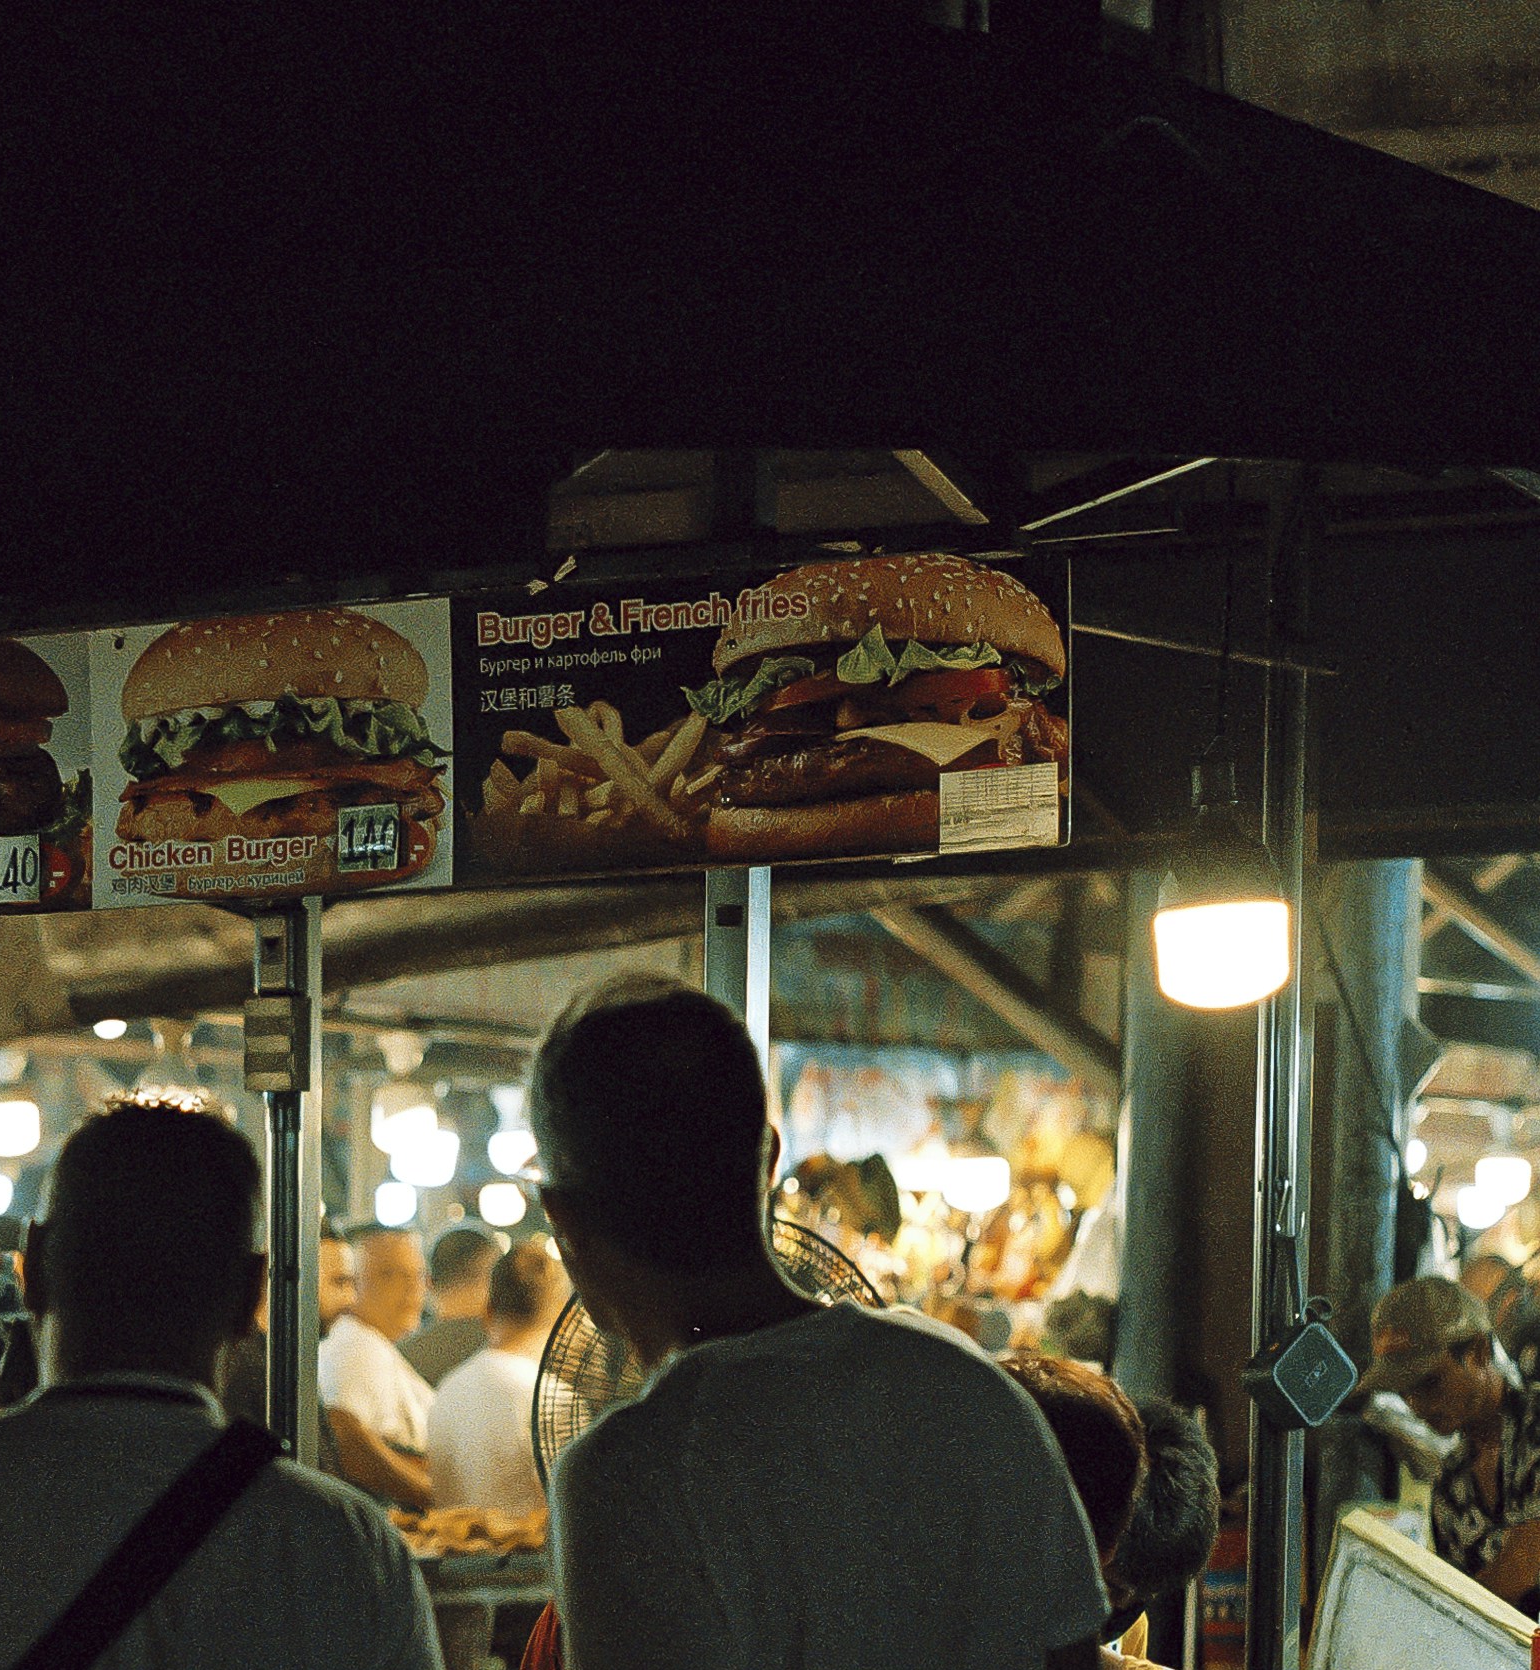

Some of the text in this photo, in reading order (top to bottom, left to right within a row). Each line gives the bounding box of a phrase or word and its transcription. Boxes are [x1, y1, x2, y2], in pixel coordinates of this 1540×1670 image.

[476, 588, 809, 649] Burger & French fries
[479, 644, 663, 678] Бургер и картофель фри
[480, 683, 576, 713] 汉堡和薯条
[108, 836, 317, 870] Chicken Burger
[340, 815, 399, 870] 140
